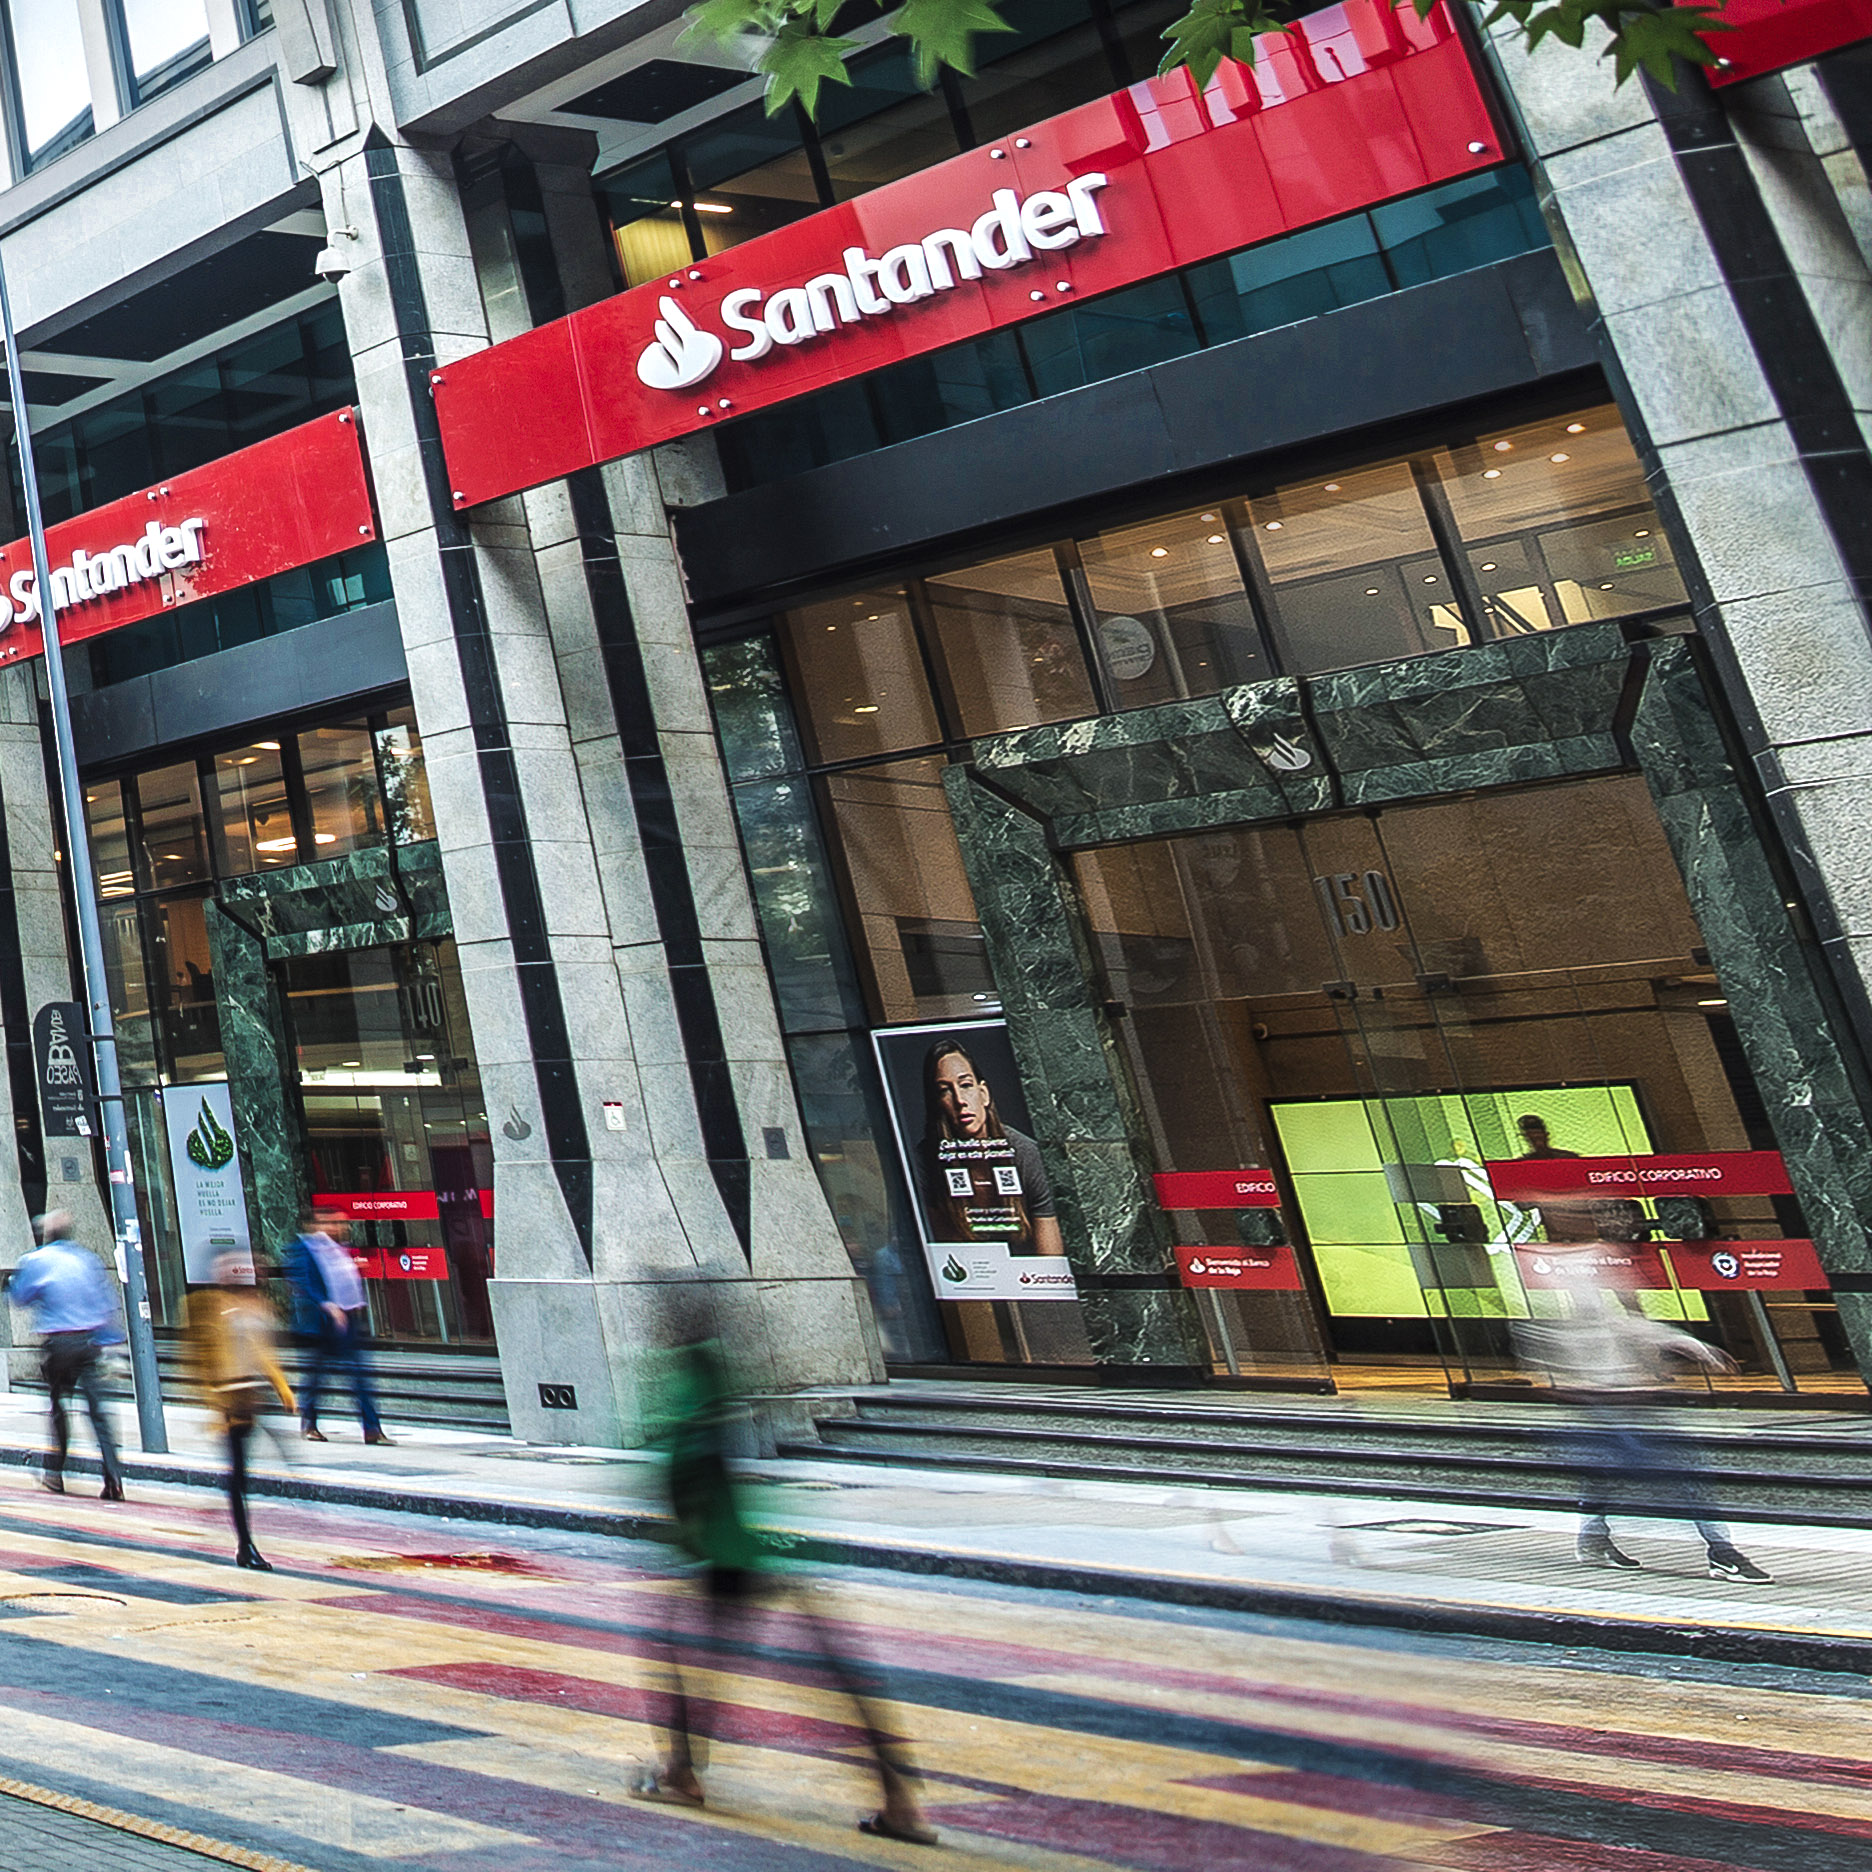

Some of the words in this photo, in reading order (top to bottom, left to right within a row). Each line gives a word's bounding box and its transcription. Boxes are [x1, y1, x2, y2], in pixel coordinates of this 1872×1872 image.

[720, 171, 1109, 363] Santander
[9, 517, 206, 625] Sntander
[1313, 869, 1401, 938] 150
[1588, 1171, 1637, 1184] EDIFICIO
[1638, 1167, 1723, 1183] CORPORATIVO
[1031, 1273, 1075, 1285] Santande
